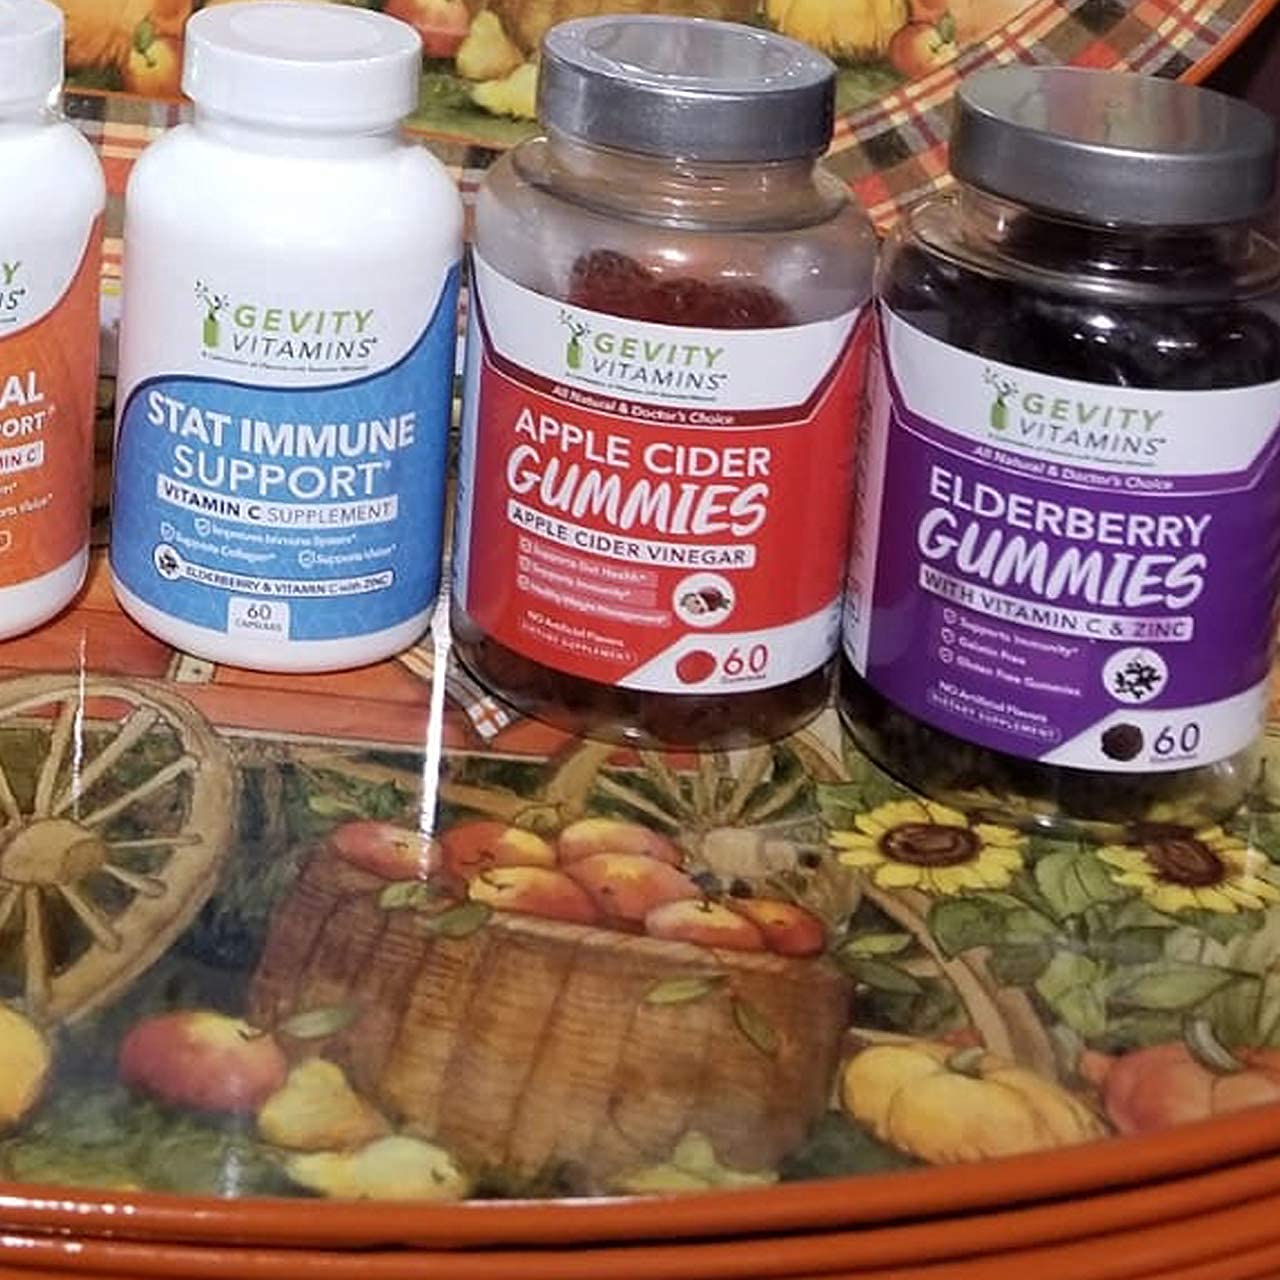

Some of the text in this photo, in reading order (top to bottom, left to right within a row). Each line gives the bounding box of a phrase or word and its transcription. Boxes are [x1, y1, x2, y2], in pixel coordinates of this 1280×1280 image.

[234, 304, 374, 335] GEVITY
[233, 333, 372, 361] VITAMINS
[594, 332, 725, 368] GEVITY
[593, 356, 720, 391] VITAMINS
[147, 390, 417, 459] STAT IMMUNE
[1022, 392, 1167, 431] GEVITY
[515, 408, 771, 478] APPLE CIDER
[1019, 419, 1162, 456] VITAMINS
[25, 448, 38, 465] C
[506, 444, 770, 536] GUMMIES
[1125, 476, 1174, 491] Choice
[163, 481, 394, 524] VITAMIN C SUPPLEMENT
[929, 465, 1212, 547] ELDERBERRY
[512, 507, 569, 544] APPLE
[574, 530, 640, 559] CIDER
[646, 545, 746, 567] VINEGAR
[917, 506, 1208, 609] GUMMIES
[185, 565, 261, 592] ELDERBERRY
[274, 582, 326, 595] VITAMIN
[247, 604, 272, 620] 60
[924, 569, 1187, 638] WITH VITAMIN C & ZINC
[723, 643, 769, 676] 60
[1153, 722, 1201, 756] 60
